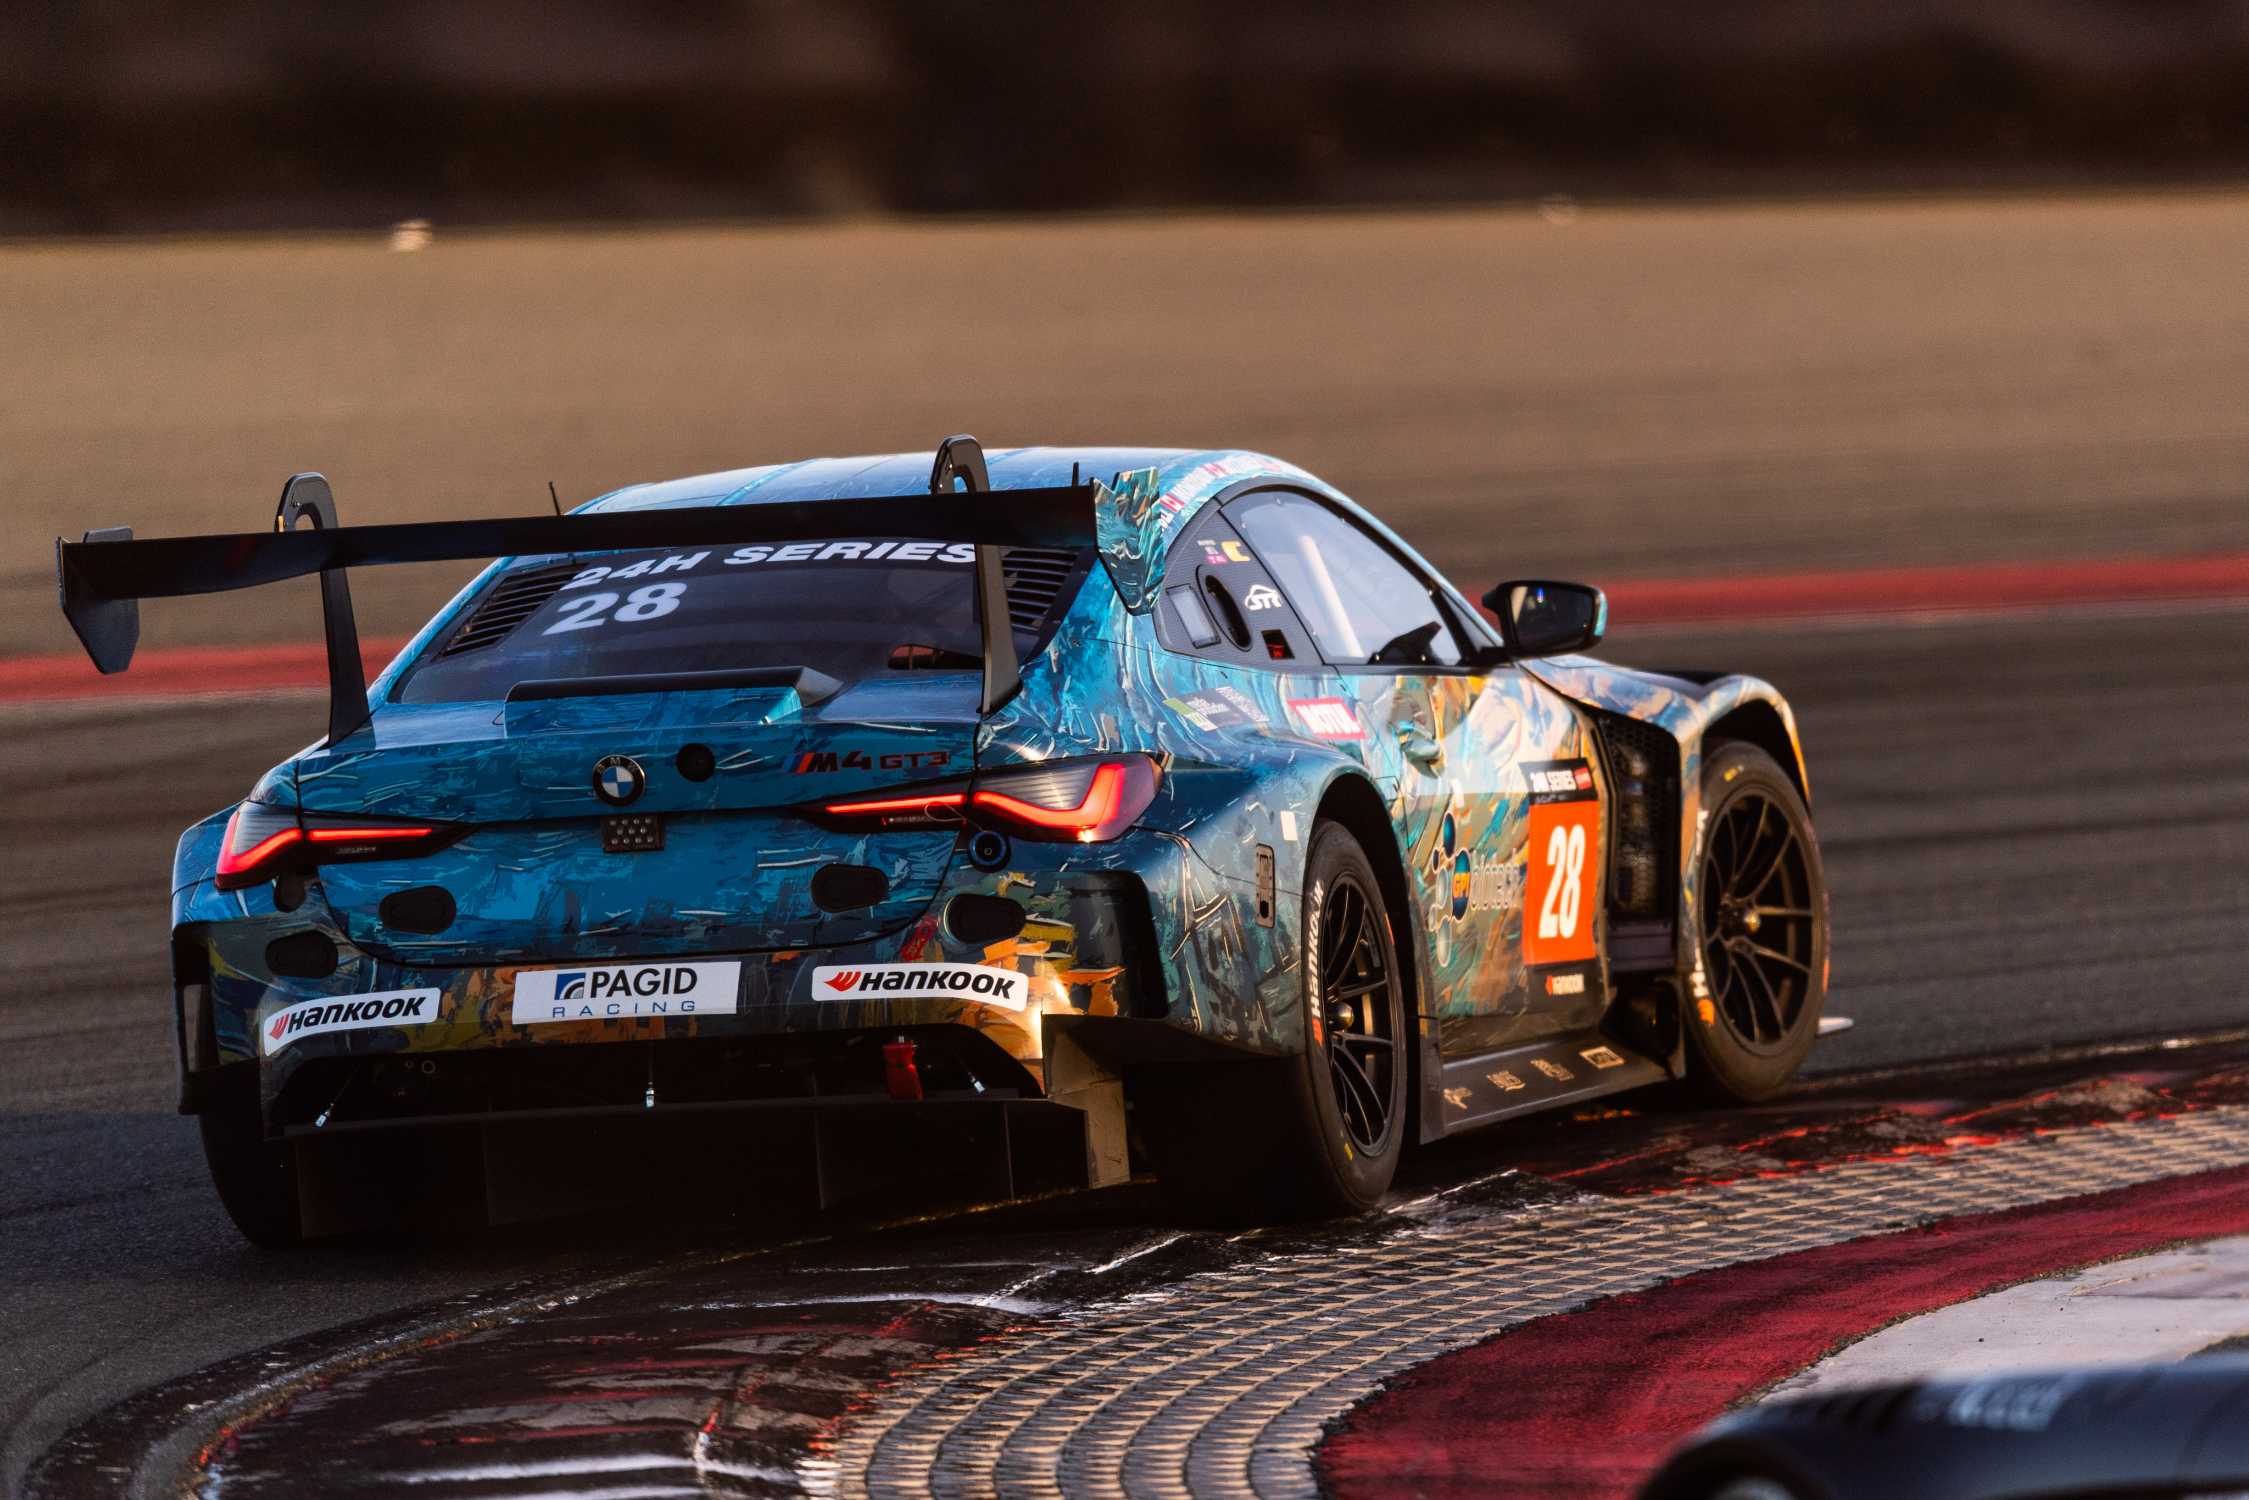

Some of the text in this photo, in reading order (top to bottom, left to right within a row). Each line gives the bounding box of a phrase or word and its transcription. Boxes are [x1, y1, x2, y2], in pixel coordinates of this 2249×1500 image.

[560, 542, 976, 591] 24H SERIES
[542, 583, 687, 636] 28
[1296, 703, 1362, 735] MOTUL
[880, 751, 949, 770] GT3
[1538, 824, 1586, 940] 28
[590, 968, 698, 999] PAGID
[552, 1001, 696, 1019] RACING
